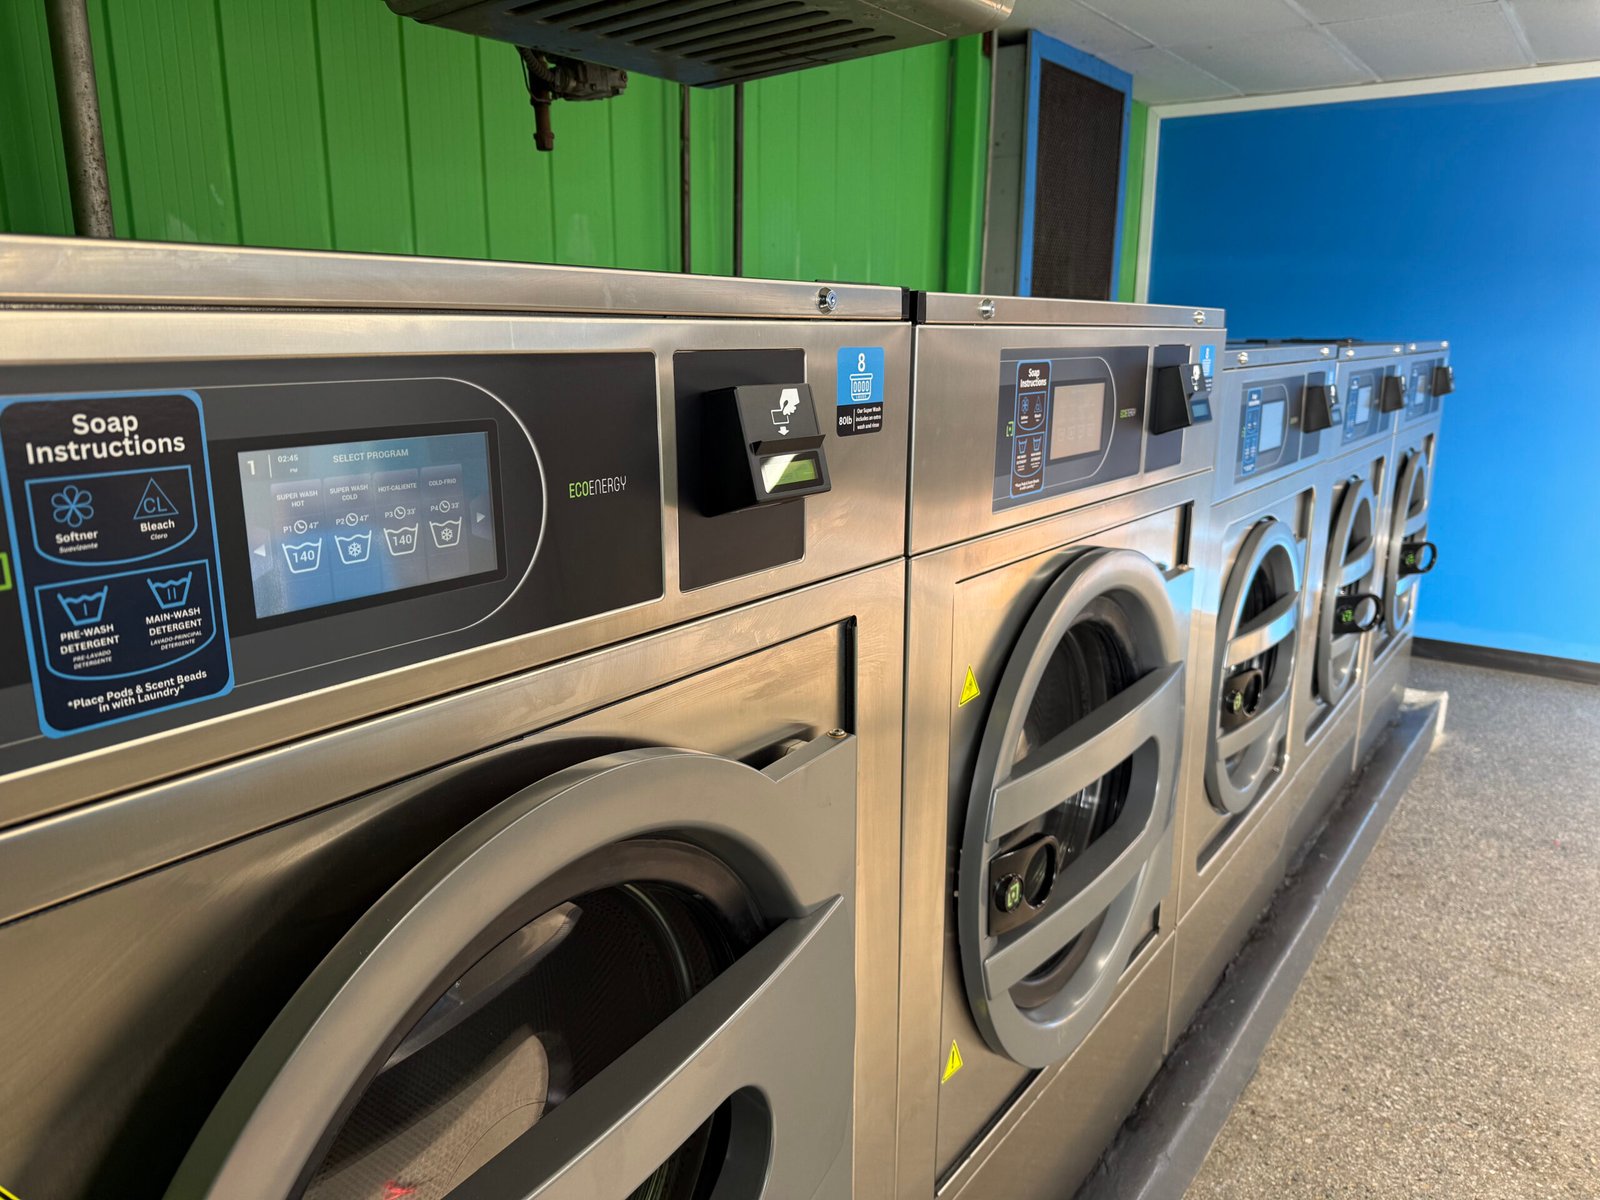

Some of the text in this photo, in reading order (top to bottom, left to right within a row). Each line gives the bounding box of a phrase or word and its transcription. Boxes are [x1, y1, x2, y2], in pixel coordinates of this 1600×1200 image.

[858, 353, 865, 372] 8
[1028, 368, 1040, 379] Soap
[1020, 378, 1047, 388] Instructions
[72, 413, 139, 437] Soap
[839, 416, 852, 425] 80lb
[25, 434, 186, 465] Instructions
[332, 449, 409, 464] SELECT PROGRAM
[277, 454, 299, 464] 02:45
[247, 460, 256, 476] 1
[329, 484, 369, 495] SUPER WASH
[377, 482, 417, 493] HOT-CALIENTE
[428, 478, 457, 487] COLD-FRIO
[569, 475, 627, 498] ECOENERGY
[276, 489, 318, 501] SUPER WASH
[341, 493, 358, 501] COLD
[143, 496, 168, 514] CL
[291, 500, 305, 508] HOT
[430, 503, 439, 512] P4
[384, 510, 394, 518] P3
[140, 518, 175, 533] Bleach
[335, 517, 346, 526] P2
[283, 525, 294, 534] P1
[55, 530, 99, 544] Softner
[392, 533, 412, 547] 140
[292, 549, 315, 564] 140
[145, 607, 201, 625] MAIN-WASH
[60, 623, 115, 642] PRE-WASH
[149, 618, 202, 636] DETERGENT
[60, 635, 120, 655] DETERGENT
[150, 630, 202, 646] LAVADO-PRINCIPAL
[160, 638, 196, 651] DETERGENTE
[72, 649, 112, 663] PRE-LAVADO
[73, 656, 113, 670] DETERGENTE
[107, 687, 134, 702] Pods
[135, 684, 143, 694] &
[145, 677, 175, 692] Scent
[177, 669, 208, 684] Beads
[112, 695, 136, 709] with
